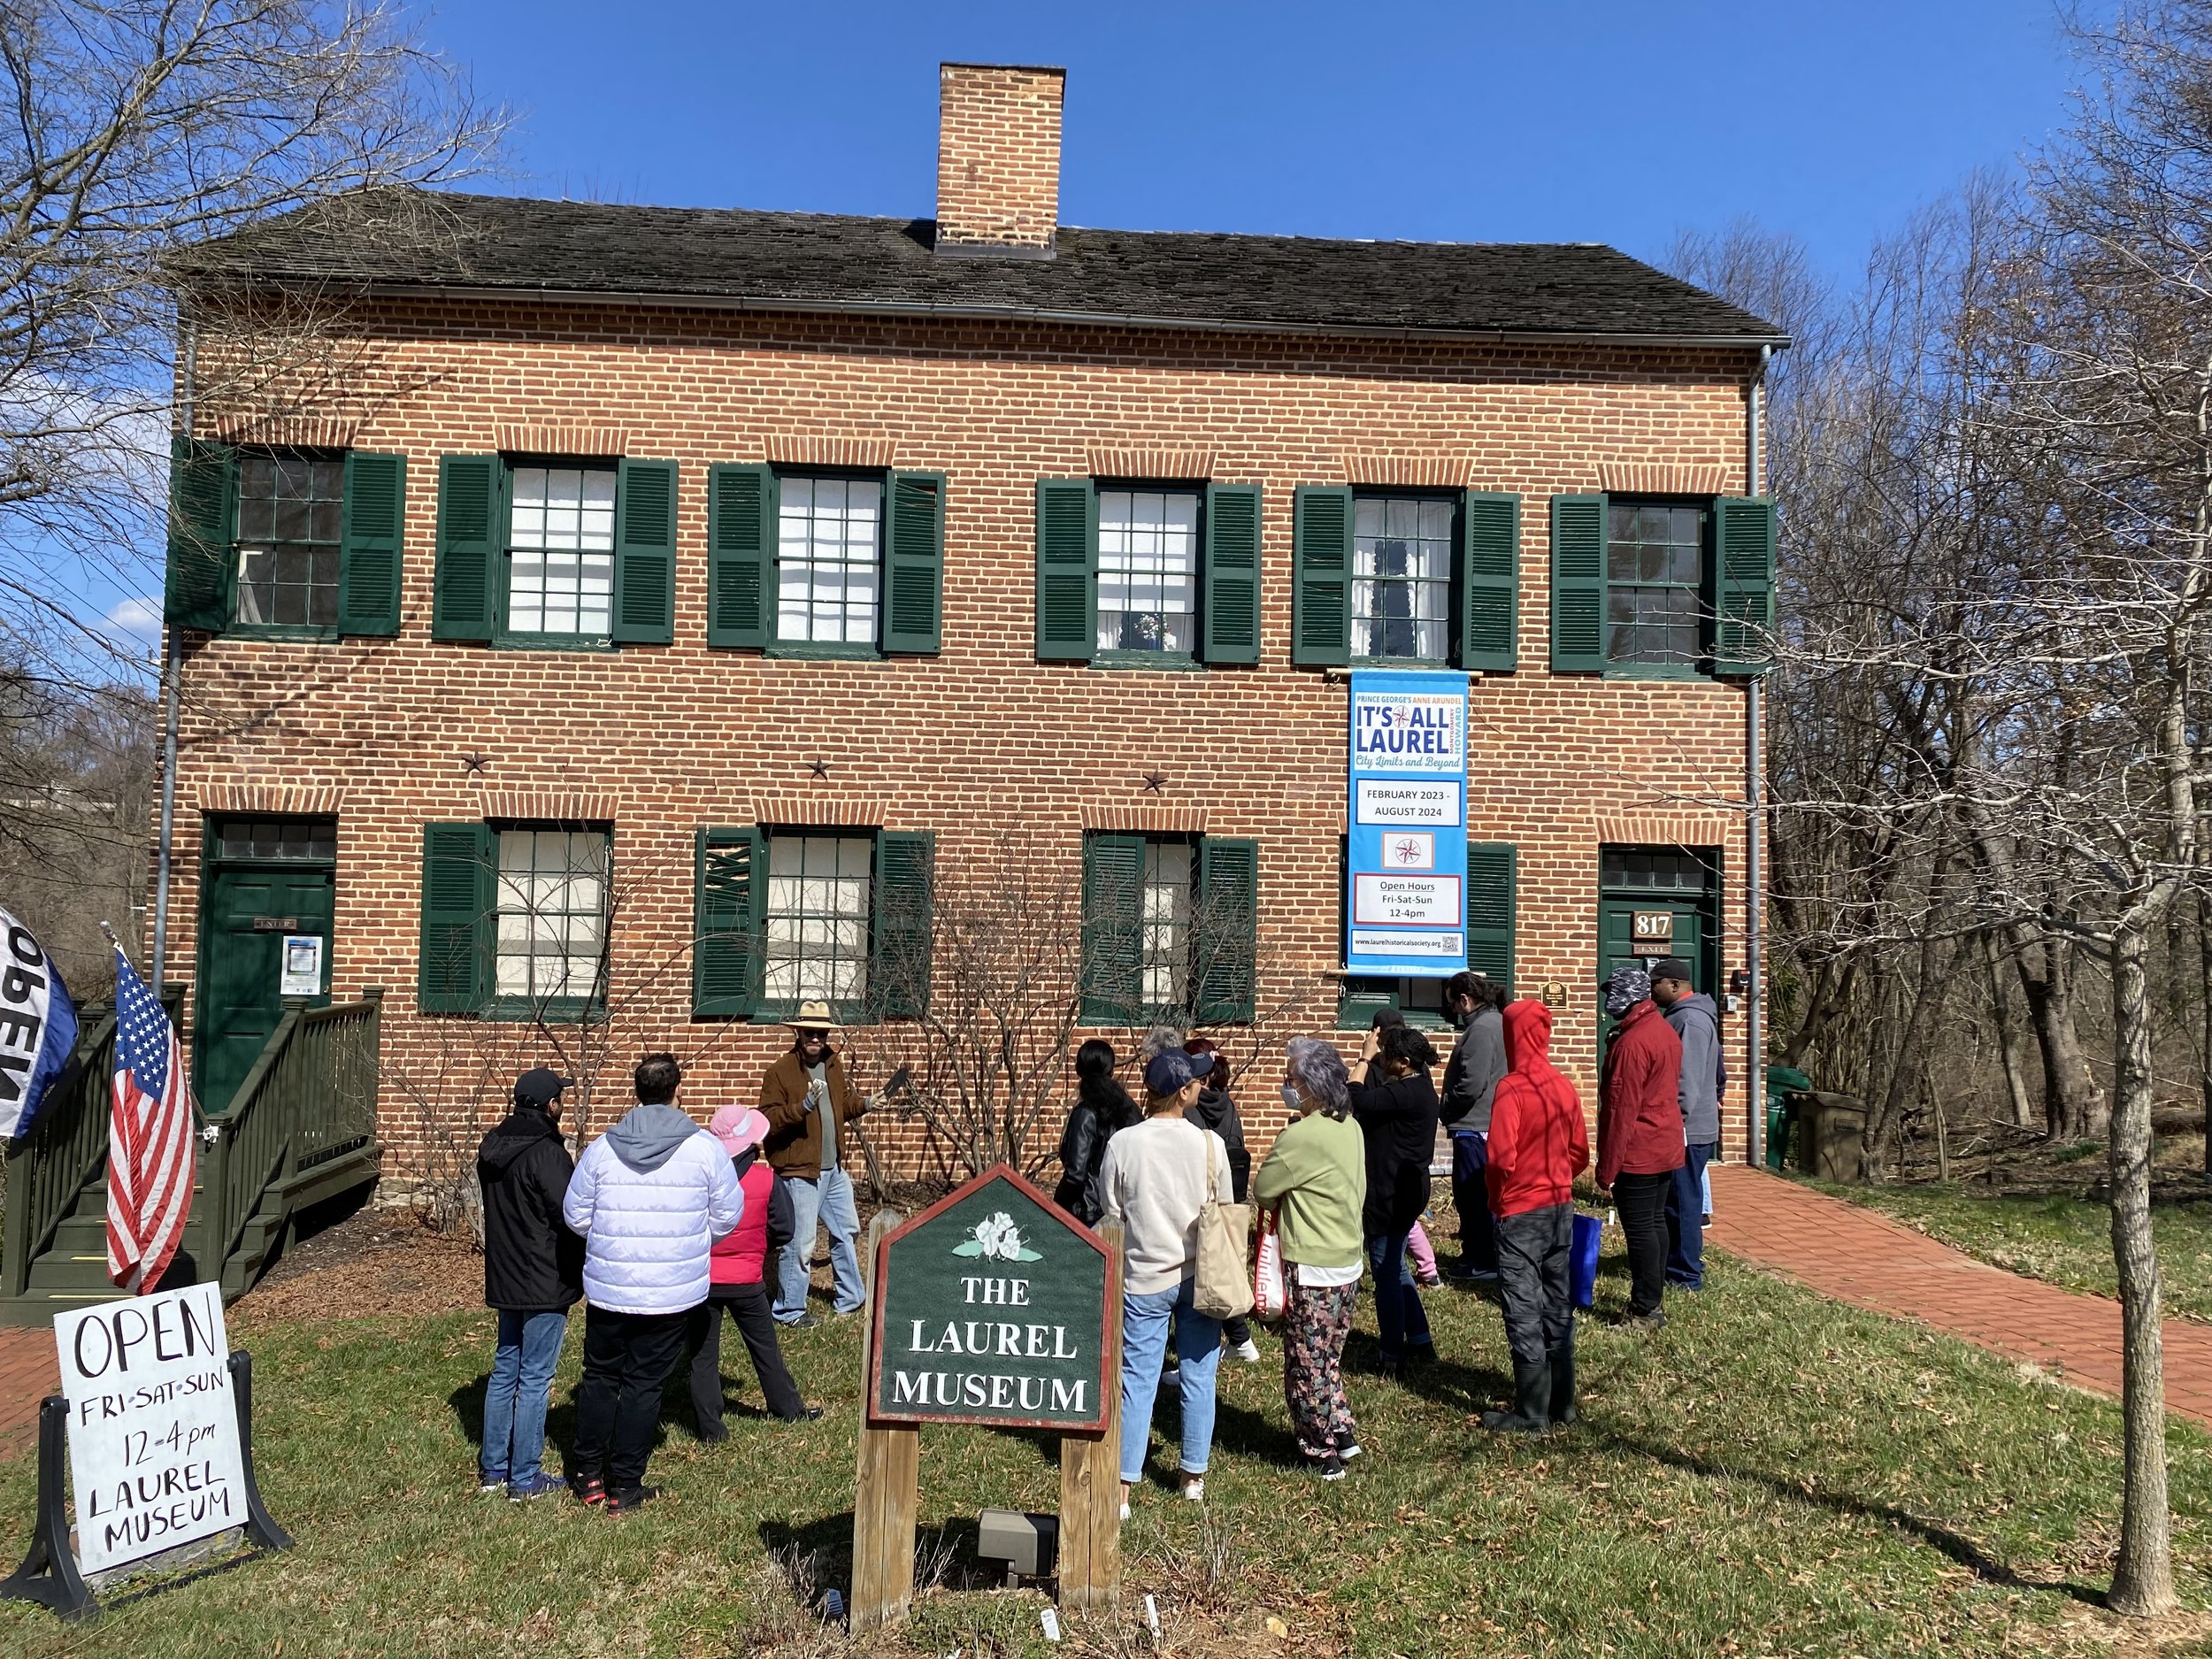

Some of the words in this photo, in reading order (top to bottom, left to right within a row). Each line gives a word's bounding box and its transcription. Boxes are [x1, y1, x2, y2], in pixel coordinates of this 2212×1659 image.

[1356, 706, 1393, 727] IT'S
[1409, 707, 1449, 728] ALL
[1356, 728, 1449, 754] LAUREL
[1356, 755, 1373, 769] City
[1375, 755, 1404, 768] Limits
[1405, 757, 1423, 767] and
[1425, 757, 1460, 771] Beyond
[1367, 789, 1417, 799] FEBRUARY
[1420, 791, 1444, 800] 2023
[1375, 807, 1416, 816] AUGUST
[1418, 808, 1442, 817] 2024
[1380, 881, 1405, 891] Open
[1408, 882, 1435, 891] Hours
[1382, 895, 1432, 904] Fri-Sat-Sun
[1389, 909, 1425, 919] 12-4pm
[1637, 915, 1670, 935] 817
[1355, 939, 1441, 949] www.laurelhistoricalsociety.org
[960, 1277, 1030, 1306] THE
[73, 1291, 215, 1379] OPEN
[909, 1319, 1078, 1359] LAUREL
[892, 1371, 1088, 1413] MUSEUM
[89, 1460, 226, 1519] LAUREL
[104, 1486, 230, 1554] MUSEUM
